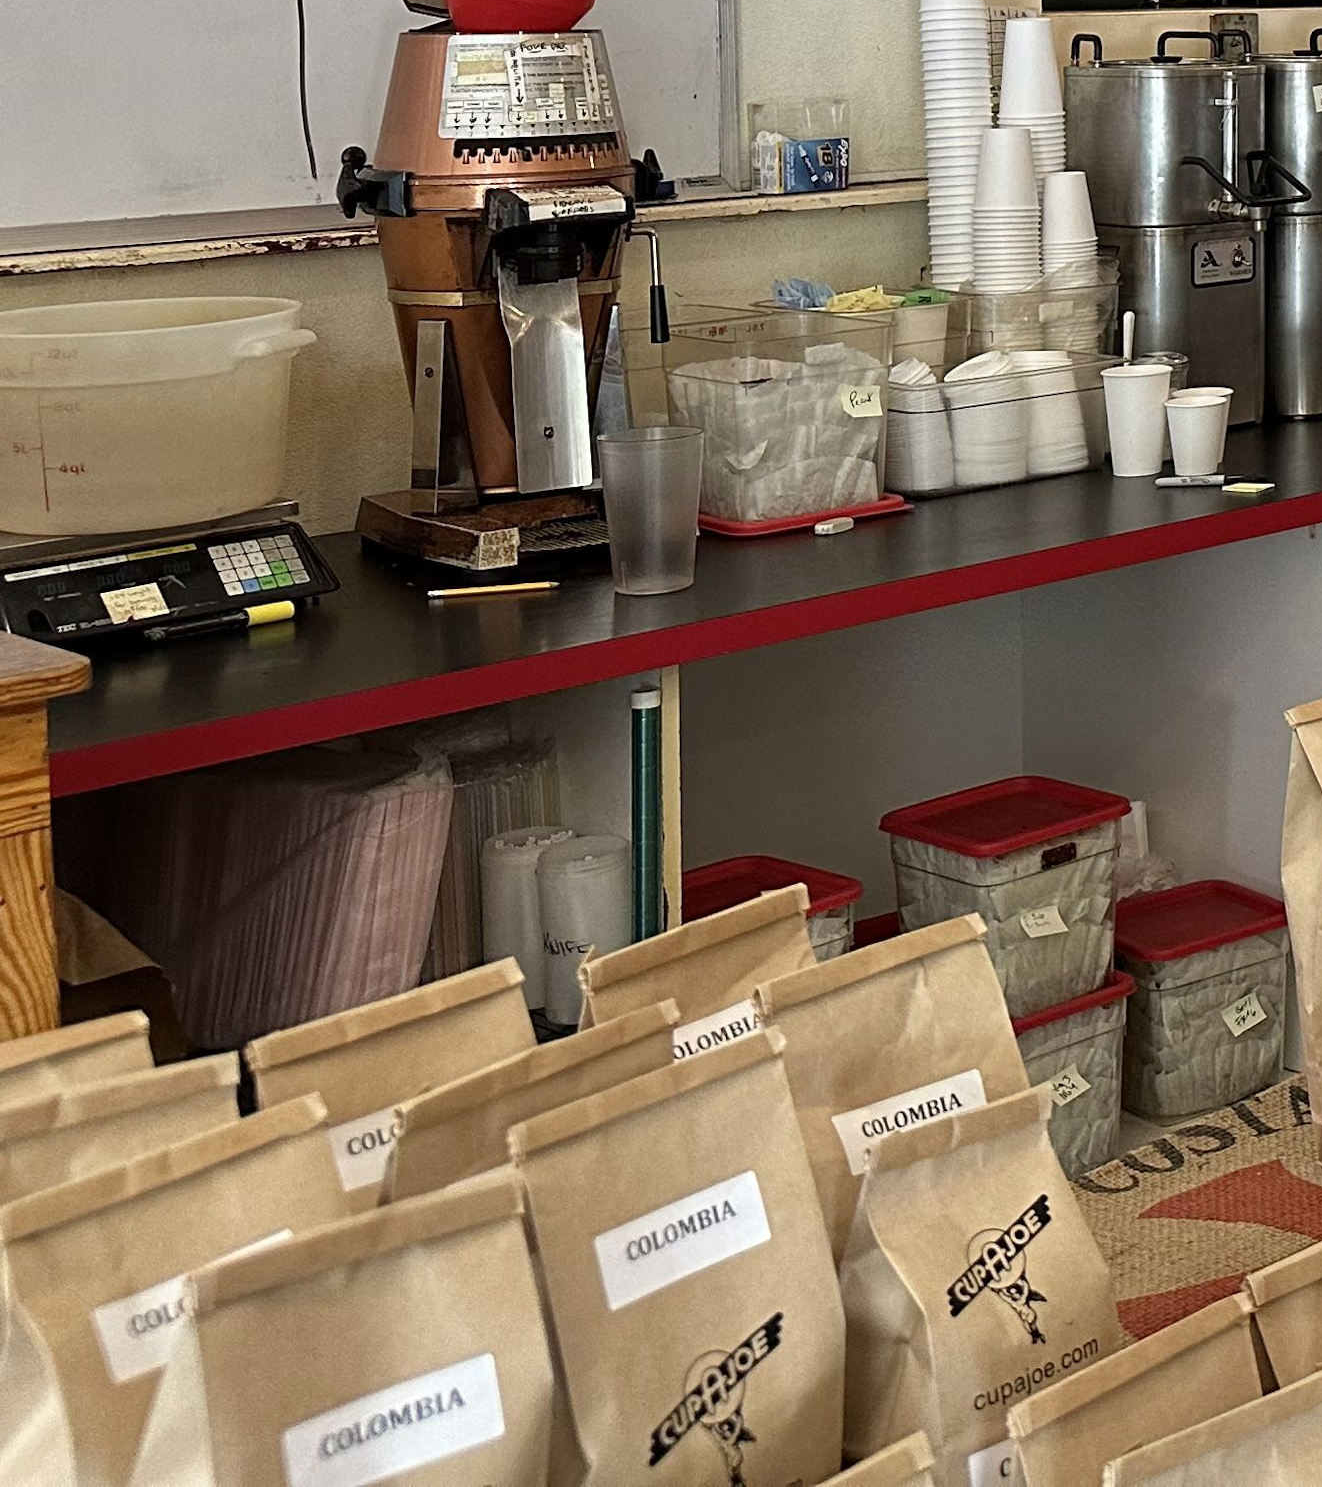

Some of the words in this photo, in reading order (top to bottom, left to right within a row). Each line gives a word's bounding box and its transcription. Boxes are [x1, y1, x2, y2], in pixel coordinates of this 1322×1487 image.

[672, 1011, 763, 1060] OLOMBIA
[862, 1093, 962, 1140] COLOMBIA
[626, 1199, 737, 1262] COLOMBIA
[972, 1335, 1100, 1411] cupajoe.com
[319, 1387, 466, 1459] COLOMBIA
